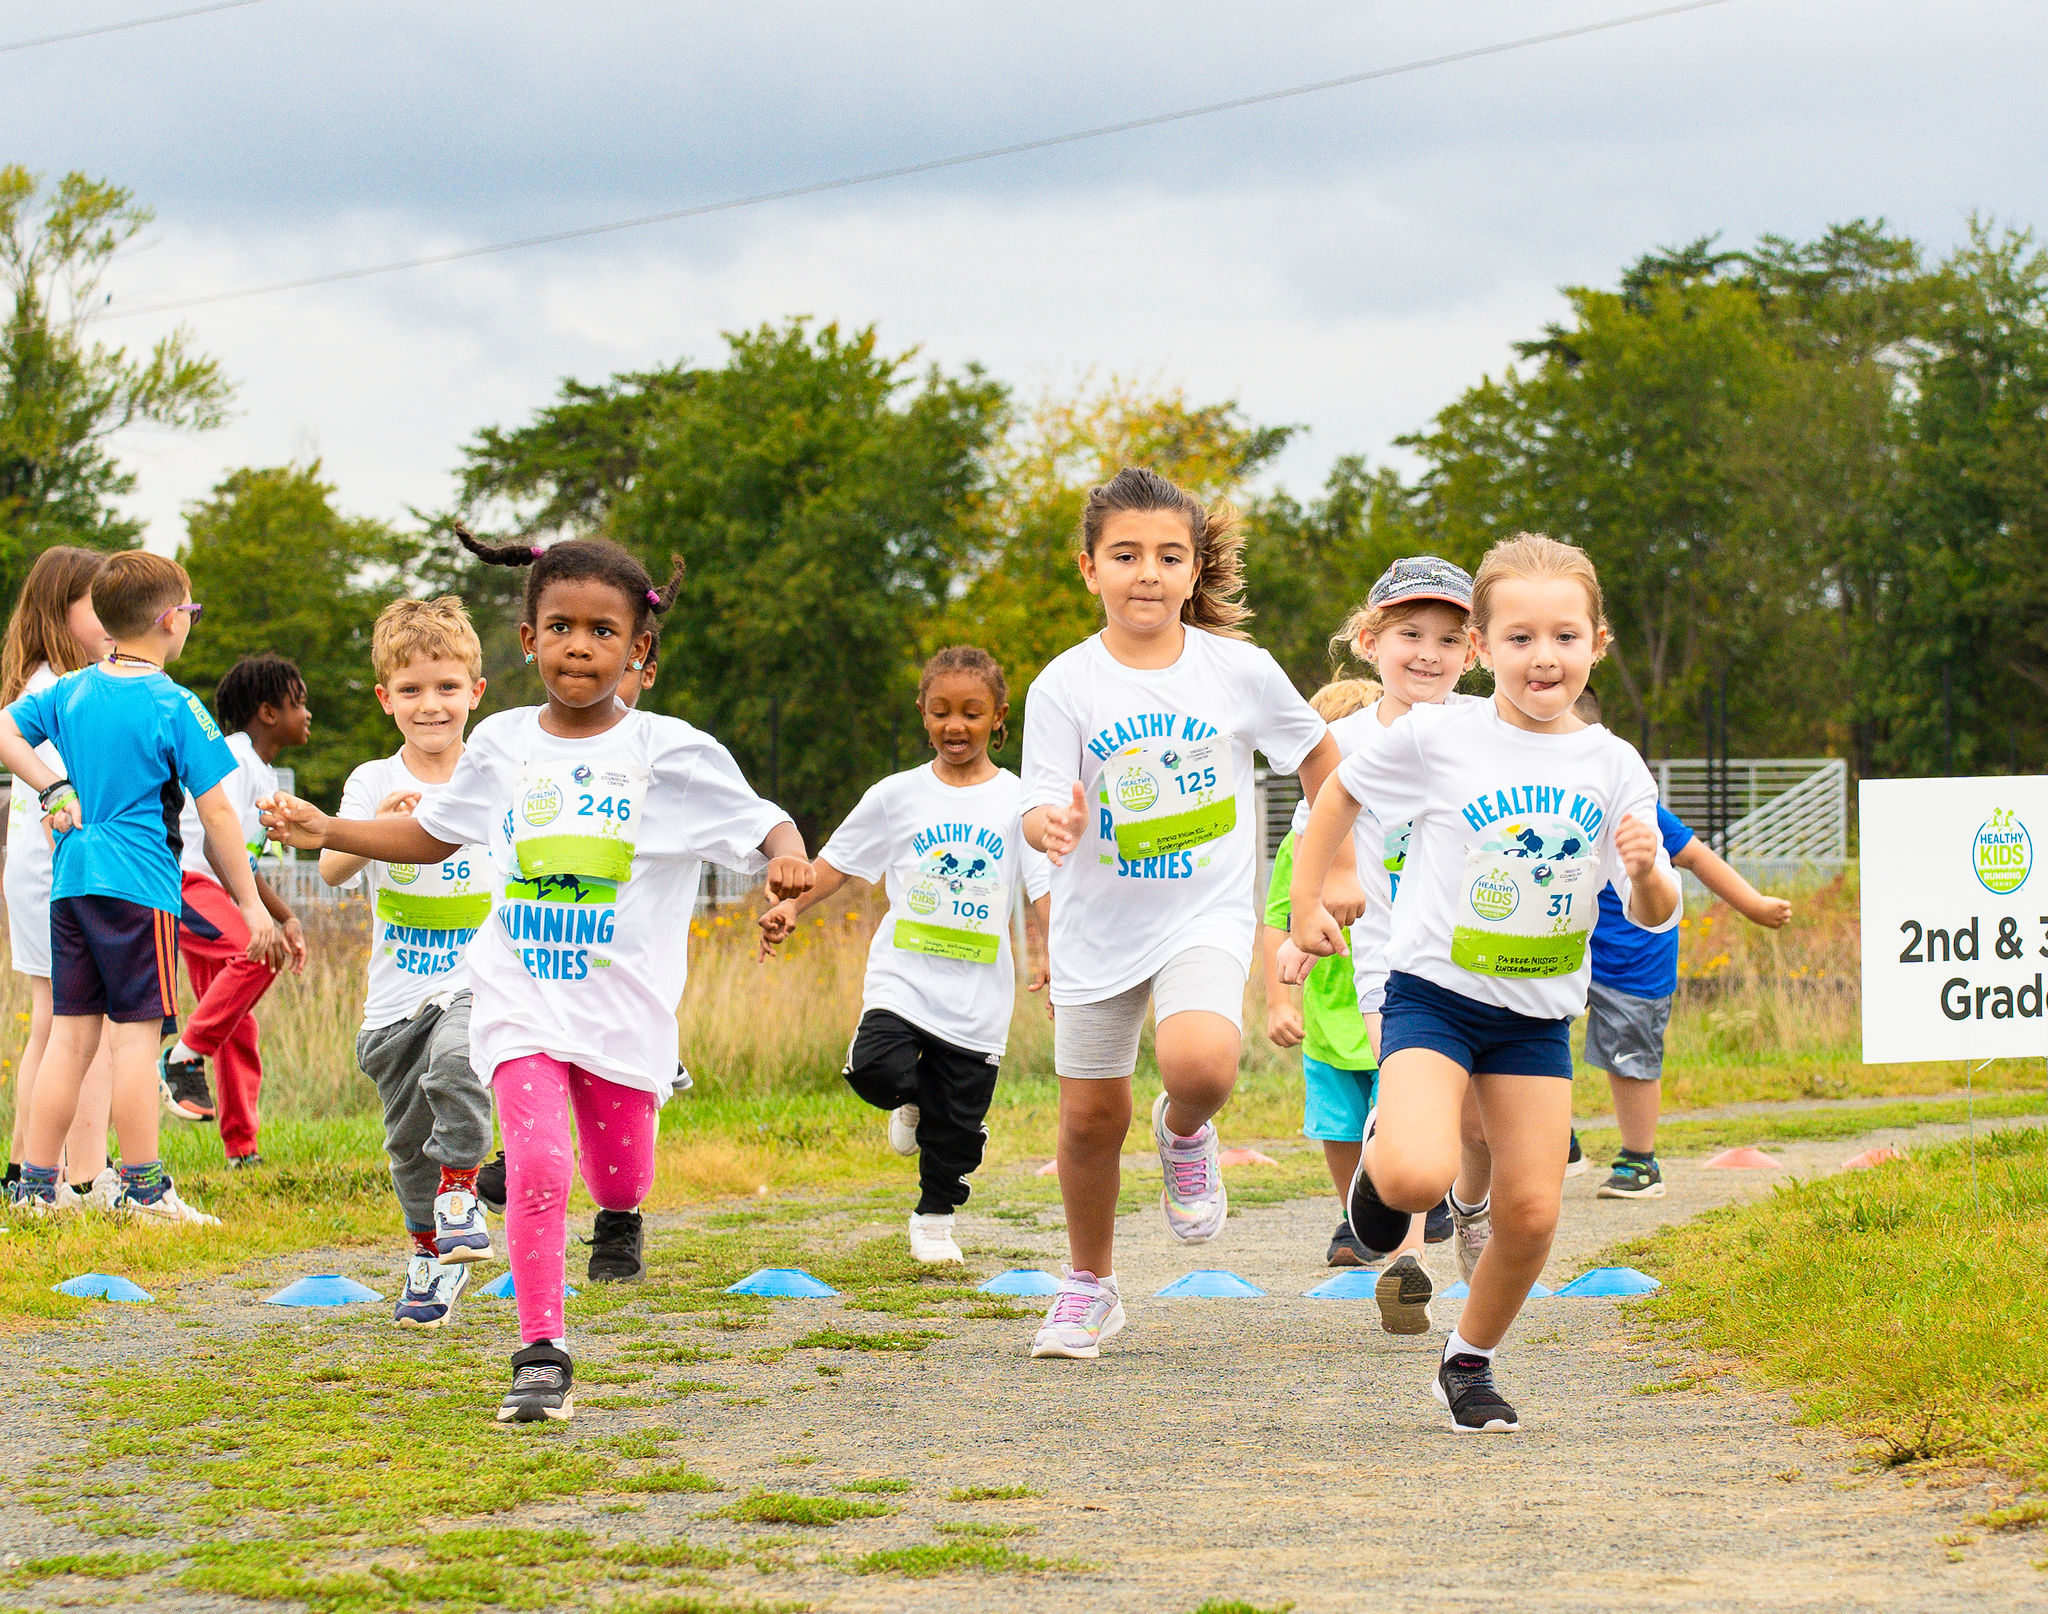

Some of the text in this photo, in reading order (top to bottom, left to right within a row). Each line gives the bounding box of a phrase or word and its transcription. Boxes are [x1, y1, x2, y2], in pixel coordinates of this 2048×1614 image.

[1087, 713, 1176, 762] HEALTHY
[1122, 783, 1153, 799] KIDS
[1175, 766, 1217, 796] 125
[527, 796, 557, 812] KIDS
[577, 794, 631, 821] 246
[1462, 785, 1565, 832] HEALTHY
[912, 823, 973, 857] HEALTHY
[1980, 832, 2024, 844] HEALTHY
[1118, 850, 1192, 879] SERIES
[1980, 843, 2024, 866] KIDS
[441, 860, 471, 881] 56
[1983, 872, 2021, 881] RUNNING
[911, 892, 936, 905] KIDS
[1476, 887, 1513, 906] KIDS
[1478, 881, 1515, 894] HEALTHY
[952, 900, 989, 919] 106
[1546, 893, 1573, 917] 31
[1899, 916, 1979, 963] 2nd
[1995, 916, 2024, 960] &
[518, 948, 588, 980] ERIES
[592, 958, 611, 968] 2024
[1941, 972, 2048, 1021] Grad
